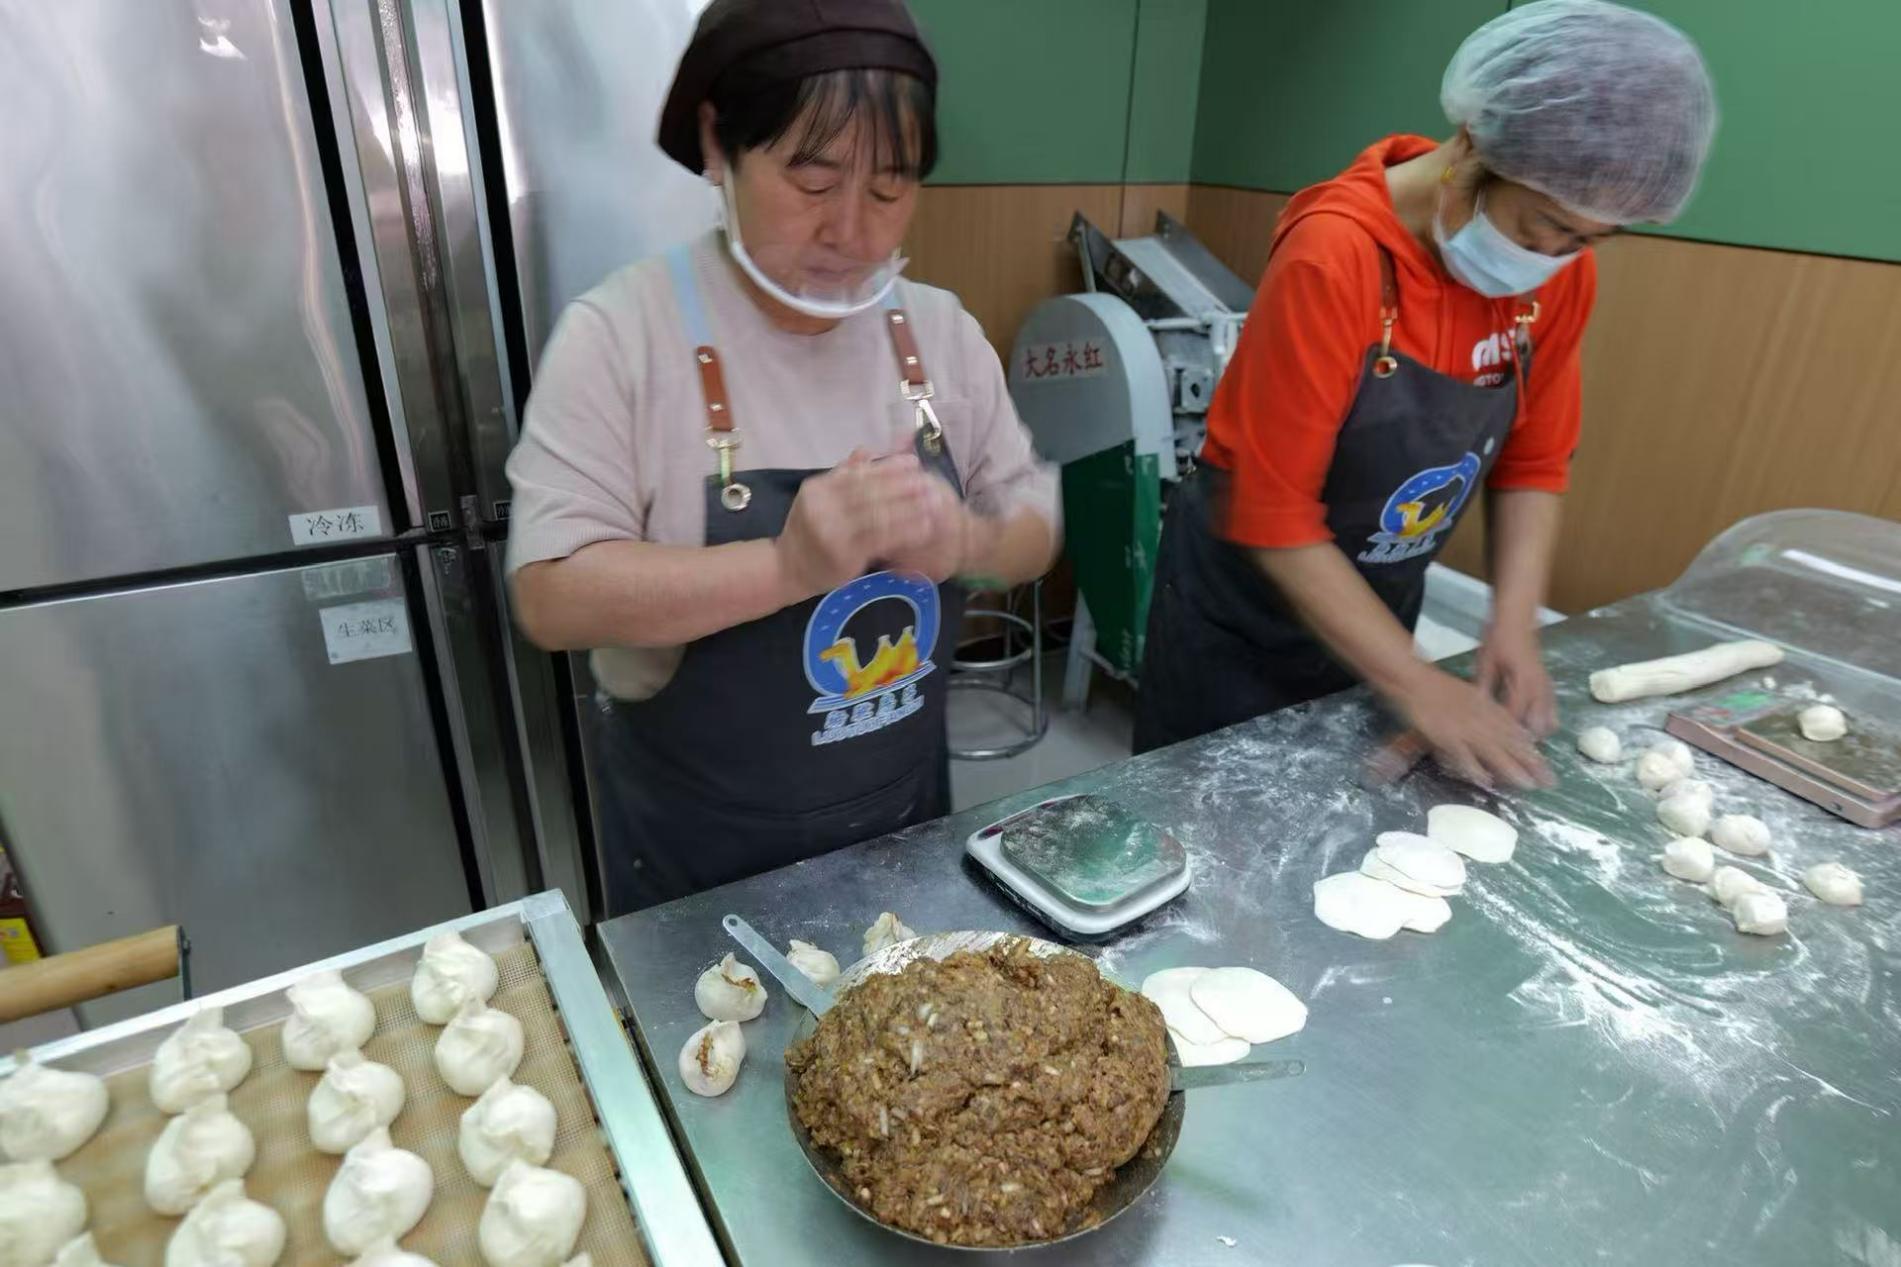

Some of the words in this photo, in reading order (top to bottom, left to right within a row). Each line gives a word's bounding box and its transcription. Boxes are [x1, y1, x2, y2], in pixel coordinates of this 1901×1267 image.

[306, 512, 364, 537] 冷冻
[338, 617, 397, 638] 生菜区
